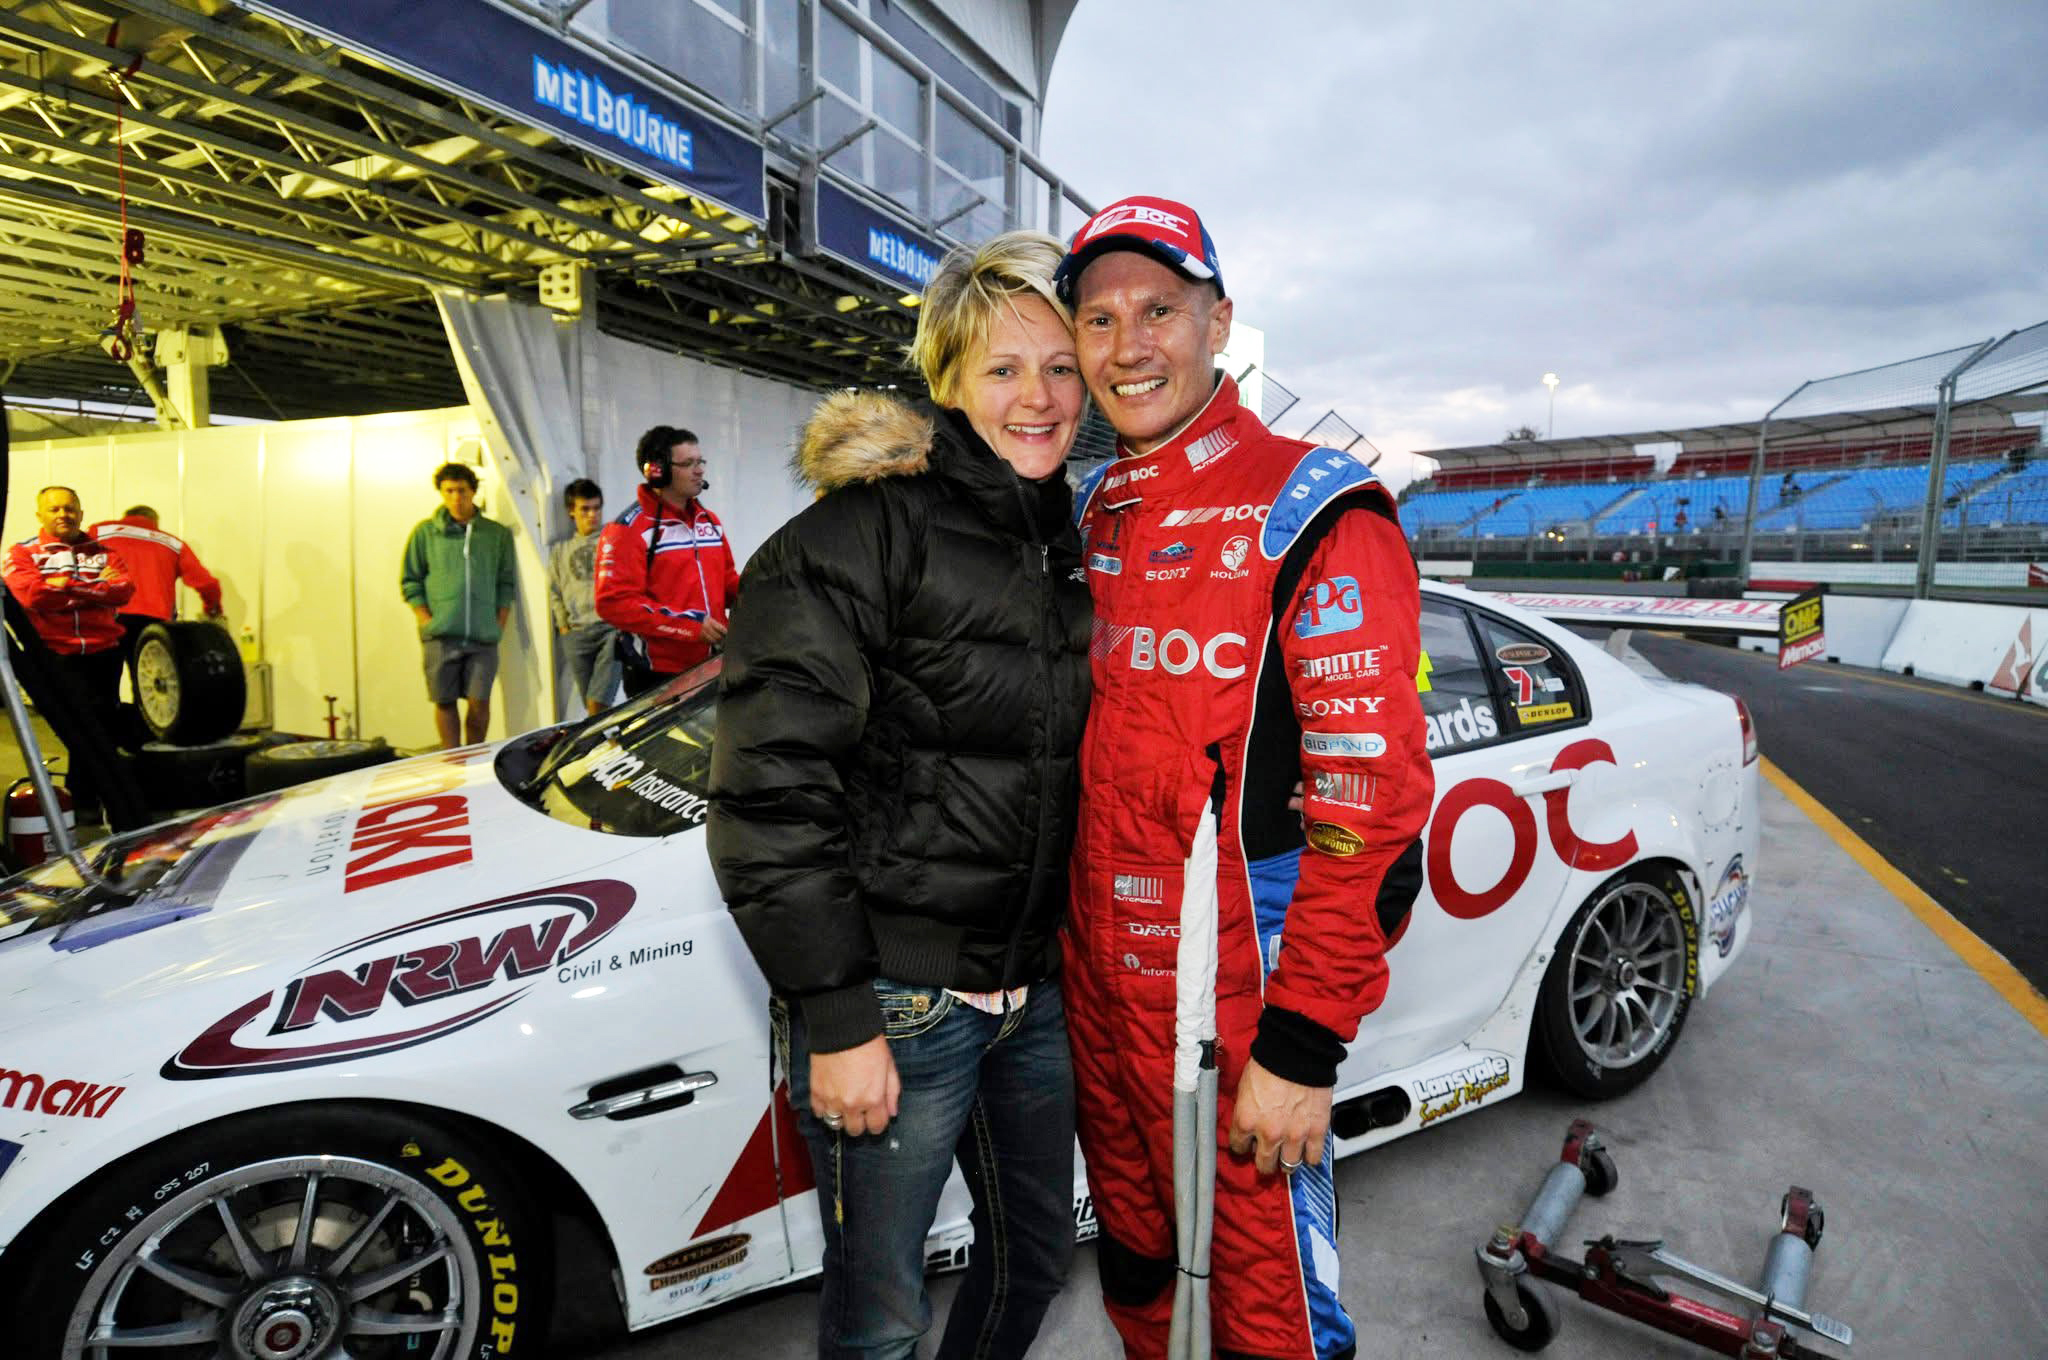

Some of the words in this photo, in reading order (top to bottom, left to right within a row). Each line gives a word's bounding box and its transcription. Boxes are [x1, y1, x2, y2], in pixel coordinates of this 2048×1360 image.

[536, 61, 693, 168] MELBOURNE
[1134, 208, 1178, 228] BOC
[1129, 465, 1159, 481] BOC
[1221, 504, 1271, 523] BOC
[1145, 566, 1191, 581] SONY
[1784, 603, 1821, 637] OMP
[1130, 626, 1247, 679] BOC
[1325, 672, 1353, 682] MODEL
[1356, 668, 1380, 678] CARS
[1299, 697, 1386, 716] SONY
[1530, 707, 1568, 718] DUNLOP
[1427, 738, 1640, 920] OC
[558, 959, 601, 984] Civil
[609, 954, 623, 971] &
[630, 939, 694, 967] Mining
[1672, 889, 1697, 997] DUNLOP
[267, 914, 577, 1037] NRW
[1412, 1056, 1510, 1103] Lansvale
[75, 1250, 95, 1270] LF
[185, 1161, 210, 1181] 207
[424, 1157, 519, 1354] DUNLOP
